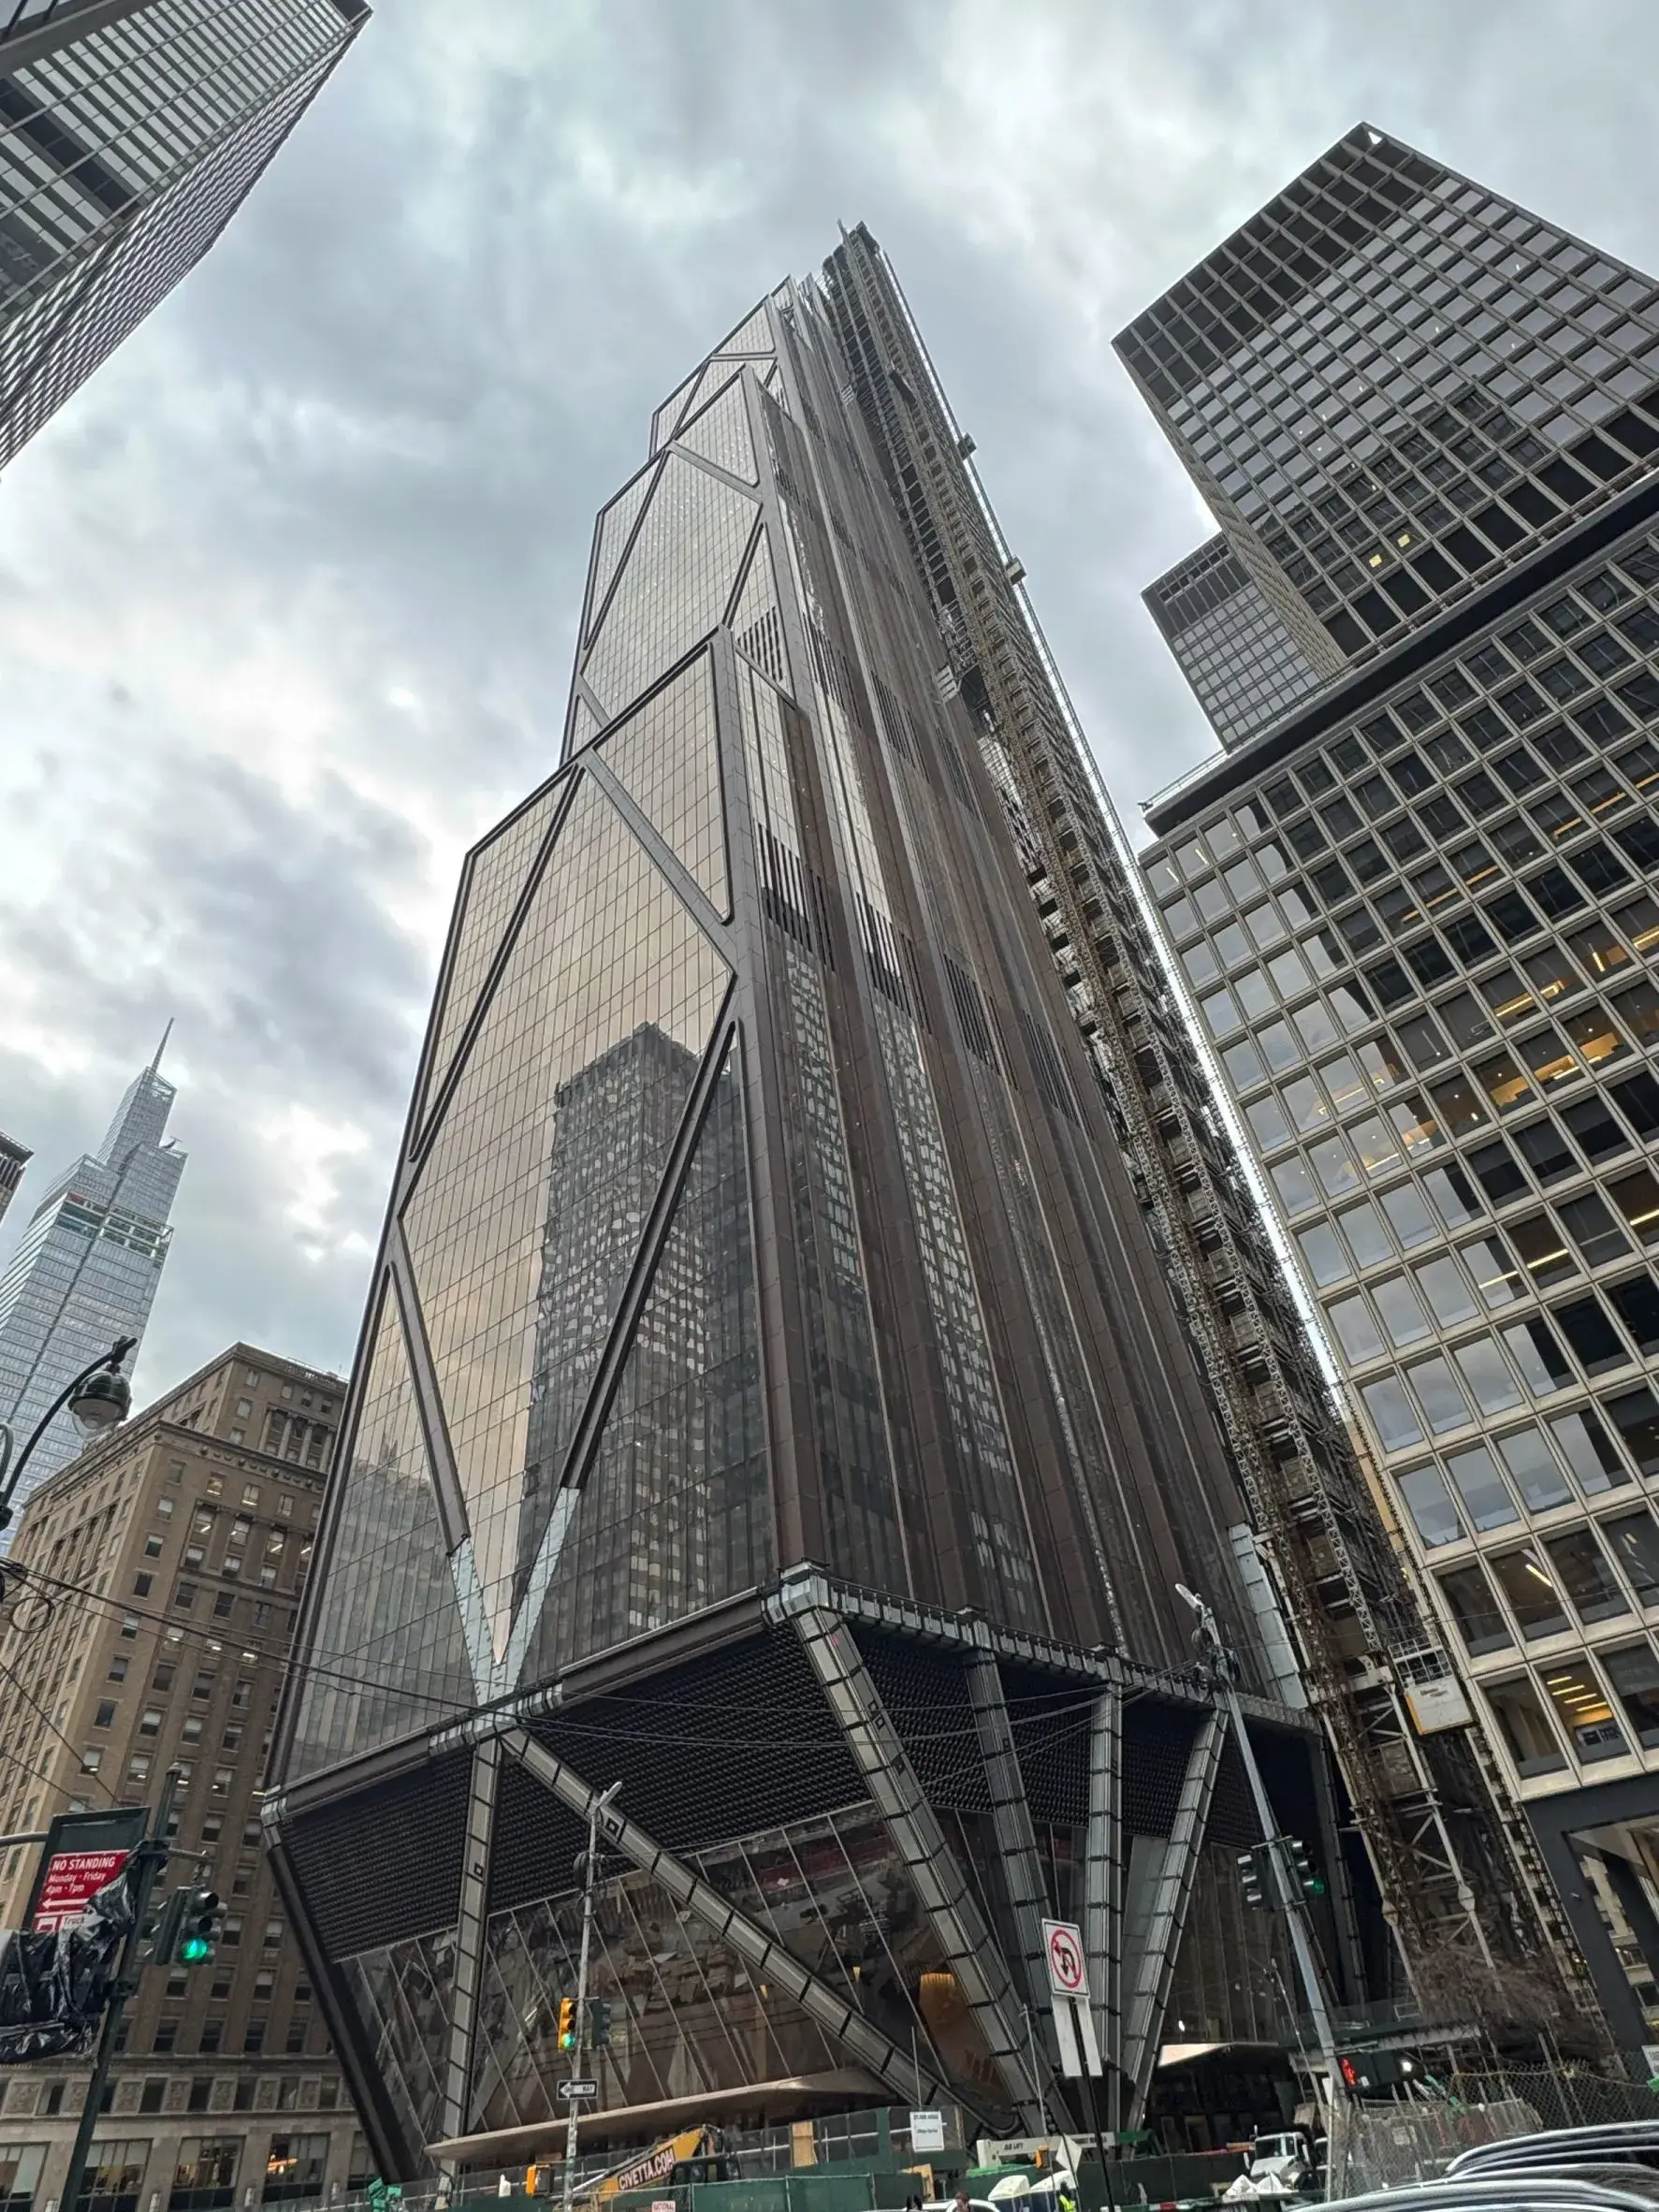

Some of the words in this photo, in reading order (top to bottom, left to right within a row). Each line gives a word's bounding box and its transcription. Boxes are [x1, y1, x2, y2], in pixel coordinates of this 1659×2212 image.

[52, 1859, 67, 1871] NO
[68, 1856, 116, 1870] STANDING
[49, 1874, 77, 1884] Monday
[83, 1871, 107, 1883] Friday
[46, 1885, 63, 1895] 4pm
[68, 1884, 85, 1895] 7pm
[618, 2147, 674, 2190] CIVETTA.COM
